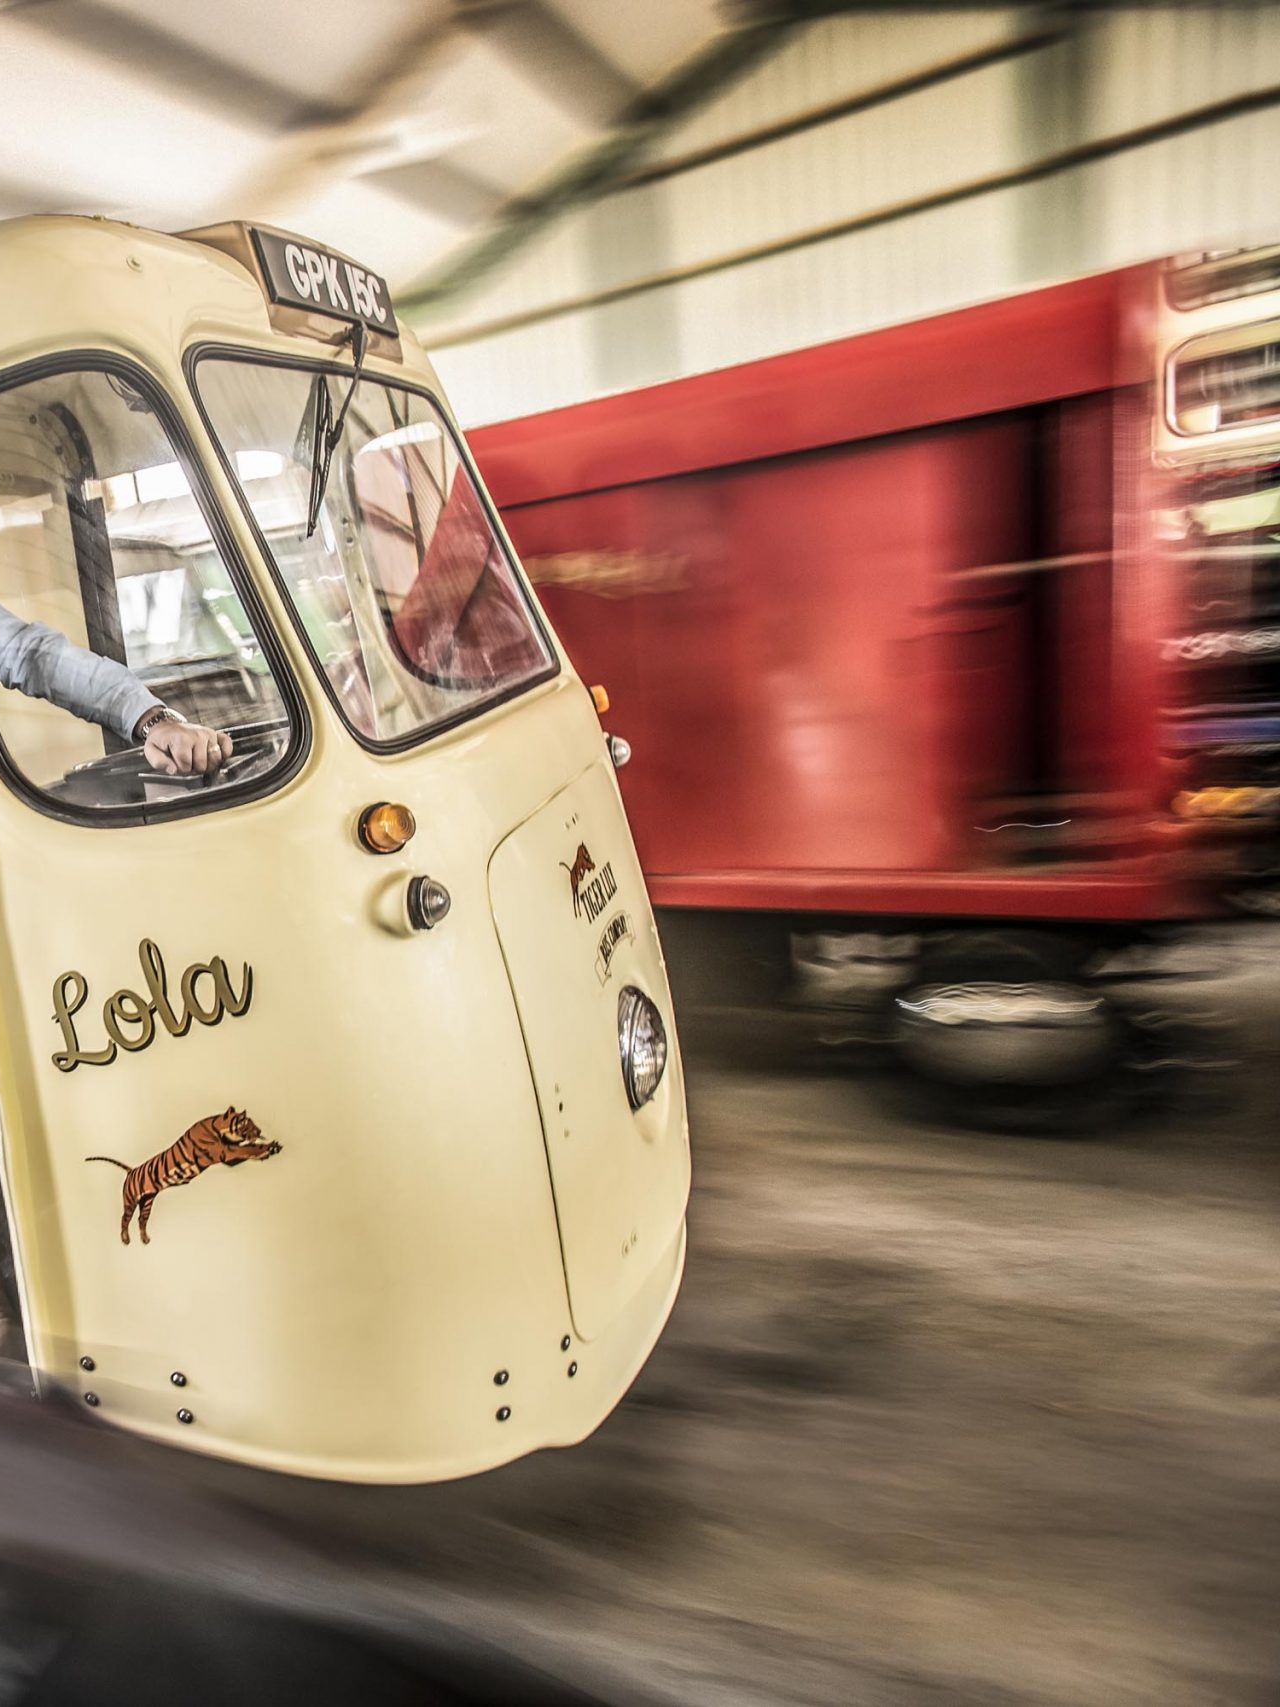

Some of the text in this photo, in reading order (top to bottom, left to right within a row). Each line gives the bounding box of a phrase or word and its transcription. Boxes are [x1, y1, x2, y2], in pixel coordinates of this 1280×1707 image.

[285, 243, 387, 324] GPK 15C
[580, 861, 618, 924] TIGER LILY
[51, 937, 254, 1073] Lola
